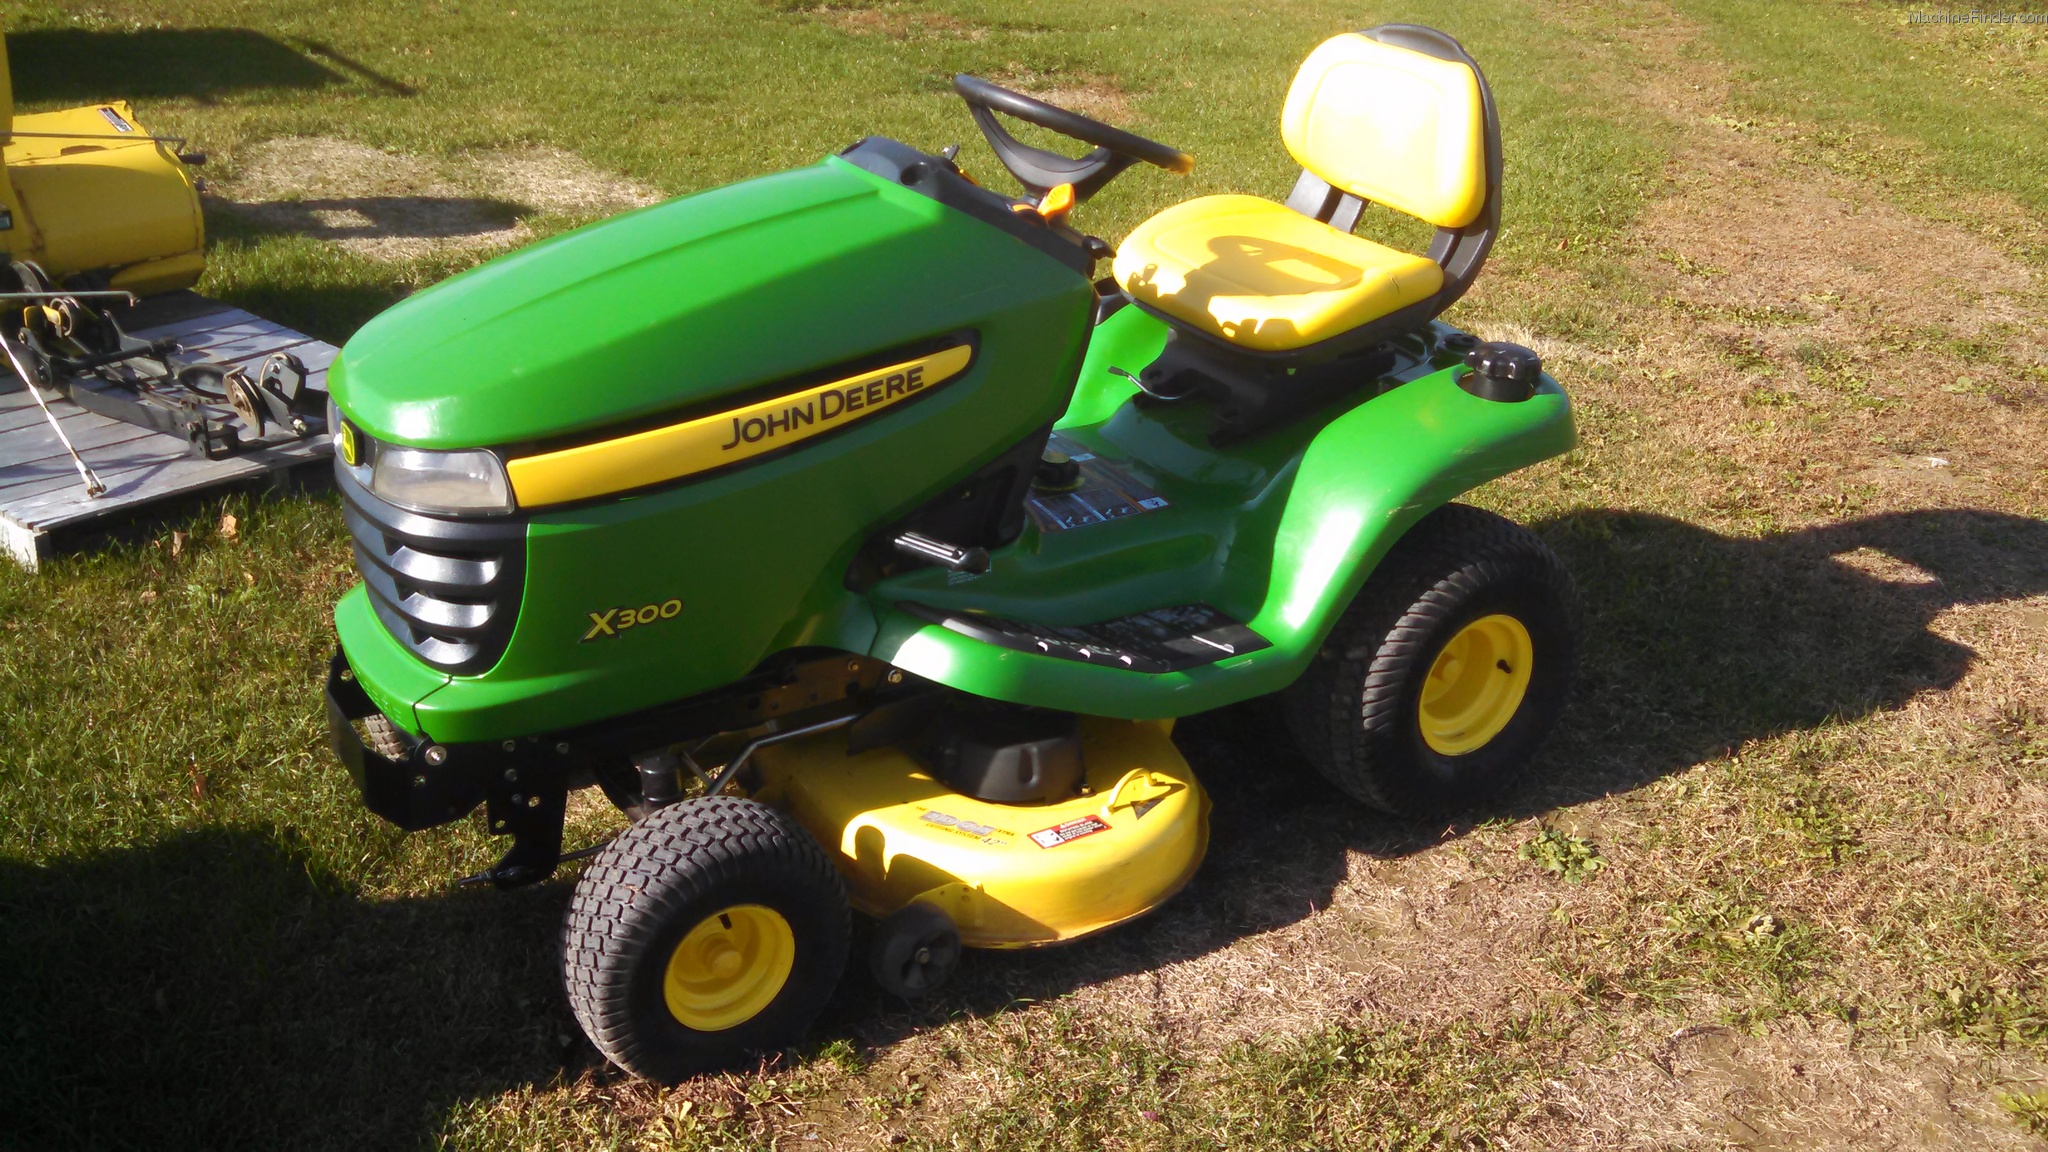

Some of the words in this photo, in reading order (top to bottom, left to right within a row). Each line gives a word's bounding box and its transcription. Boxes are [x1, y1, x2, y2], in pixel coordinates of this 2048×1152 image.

[722, 401, 814, 451] JOHN
[819, 366, 924, 421] DEERE
[579, 599, 682, 641] X300
